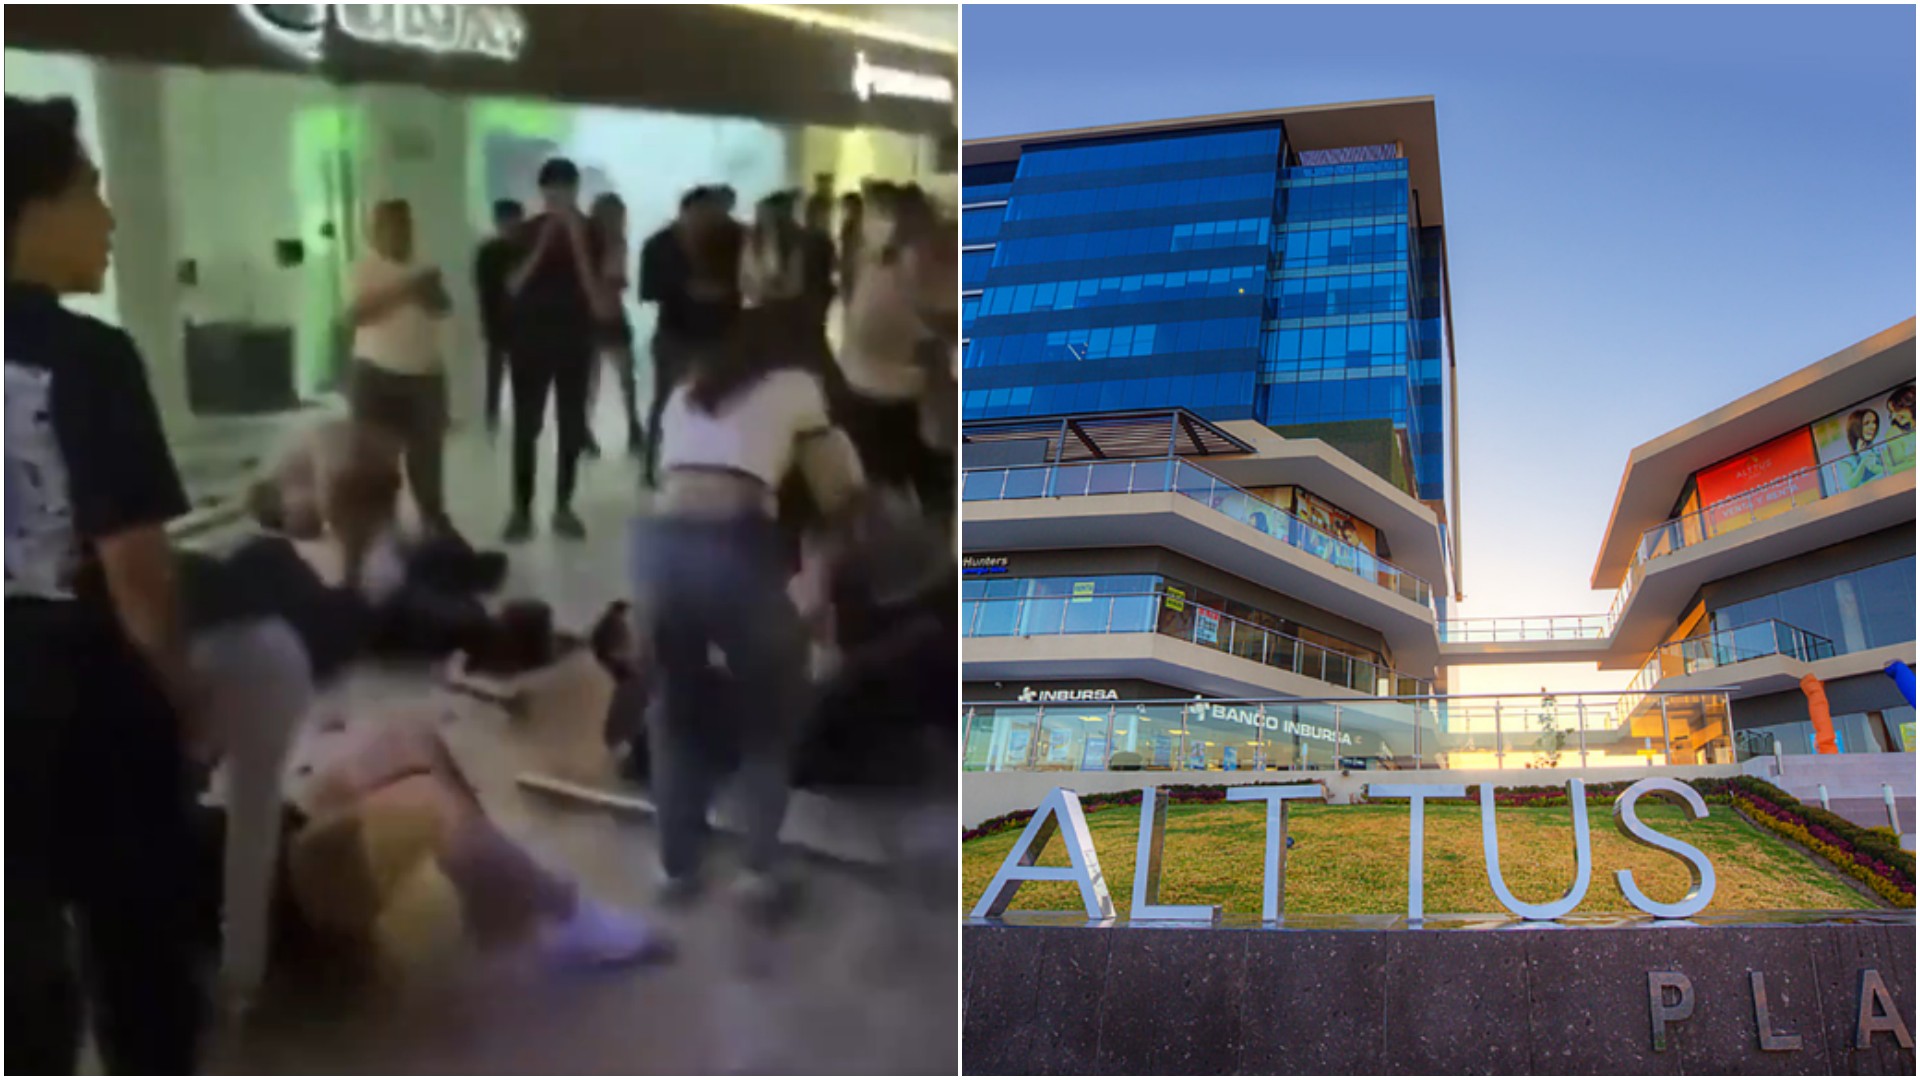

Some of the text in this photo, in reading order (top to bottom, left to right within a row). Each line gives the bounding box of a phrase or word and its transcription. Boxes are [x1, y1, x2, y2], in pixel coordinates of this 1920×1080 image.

[1039, 689, 1118, 701] INBURSA
[1212, 704, 1352, 746] BANCO INBURSA
[969, 776, 1716, 923] ALTTUS
